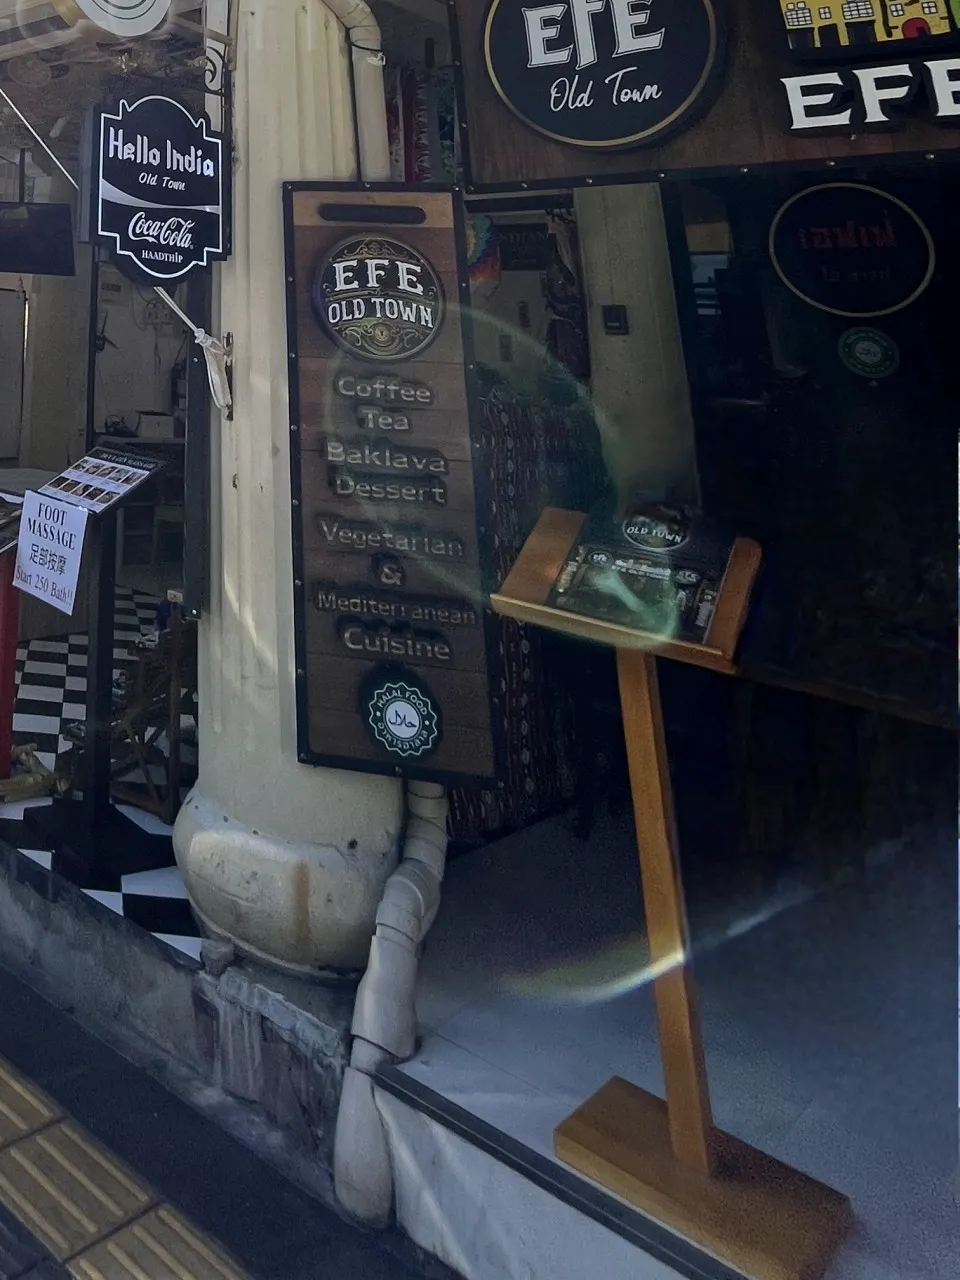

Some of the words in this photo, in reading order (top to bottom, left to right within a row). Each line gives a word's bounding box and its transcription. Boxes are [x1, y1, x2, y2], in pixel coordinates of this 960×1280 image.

[549, 75, 594, 112] Old
[604, 67, 662, 106] Town
[108, 126, 161, 166] Hello
[166, 139, 215, 178] India
[138, 172, 158, 186] Old
[162, 176, 186, 192] Town
[332, 259, 424, 296] EFE
[328, 298, 365, 324] OLD
[371, 298, 433, 328] TOWN
[338, 376, 431, 403] Coffee
[361, 409, 410, 430] Tea
[327, 442, 446, 472] Baklava
[336, 475, 446, 504] Dessert
[37, 503, 68, 526] FOOT
[27, 517, 77, 551] MASSAGE
[320, 520, 463, 556] Vegetarian
[626, 526, 648, 535] OLD
[29, 543, 67, 575] 足部按摩
[16, 565, 32, 586] Start
[35, 574, 49, 593] 250
[380, 563, 402, 586] &
[317, 591, 476, 625] Mediterranean
[344, 627, 450, 660] Cuisine
[377, 689, 403, 708] HALAL
[405, 691, 428, 715] FOOD
